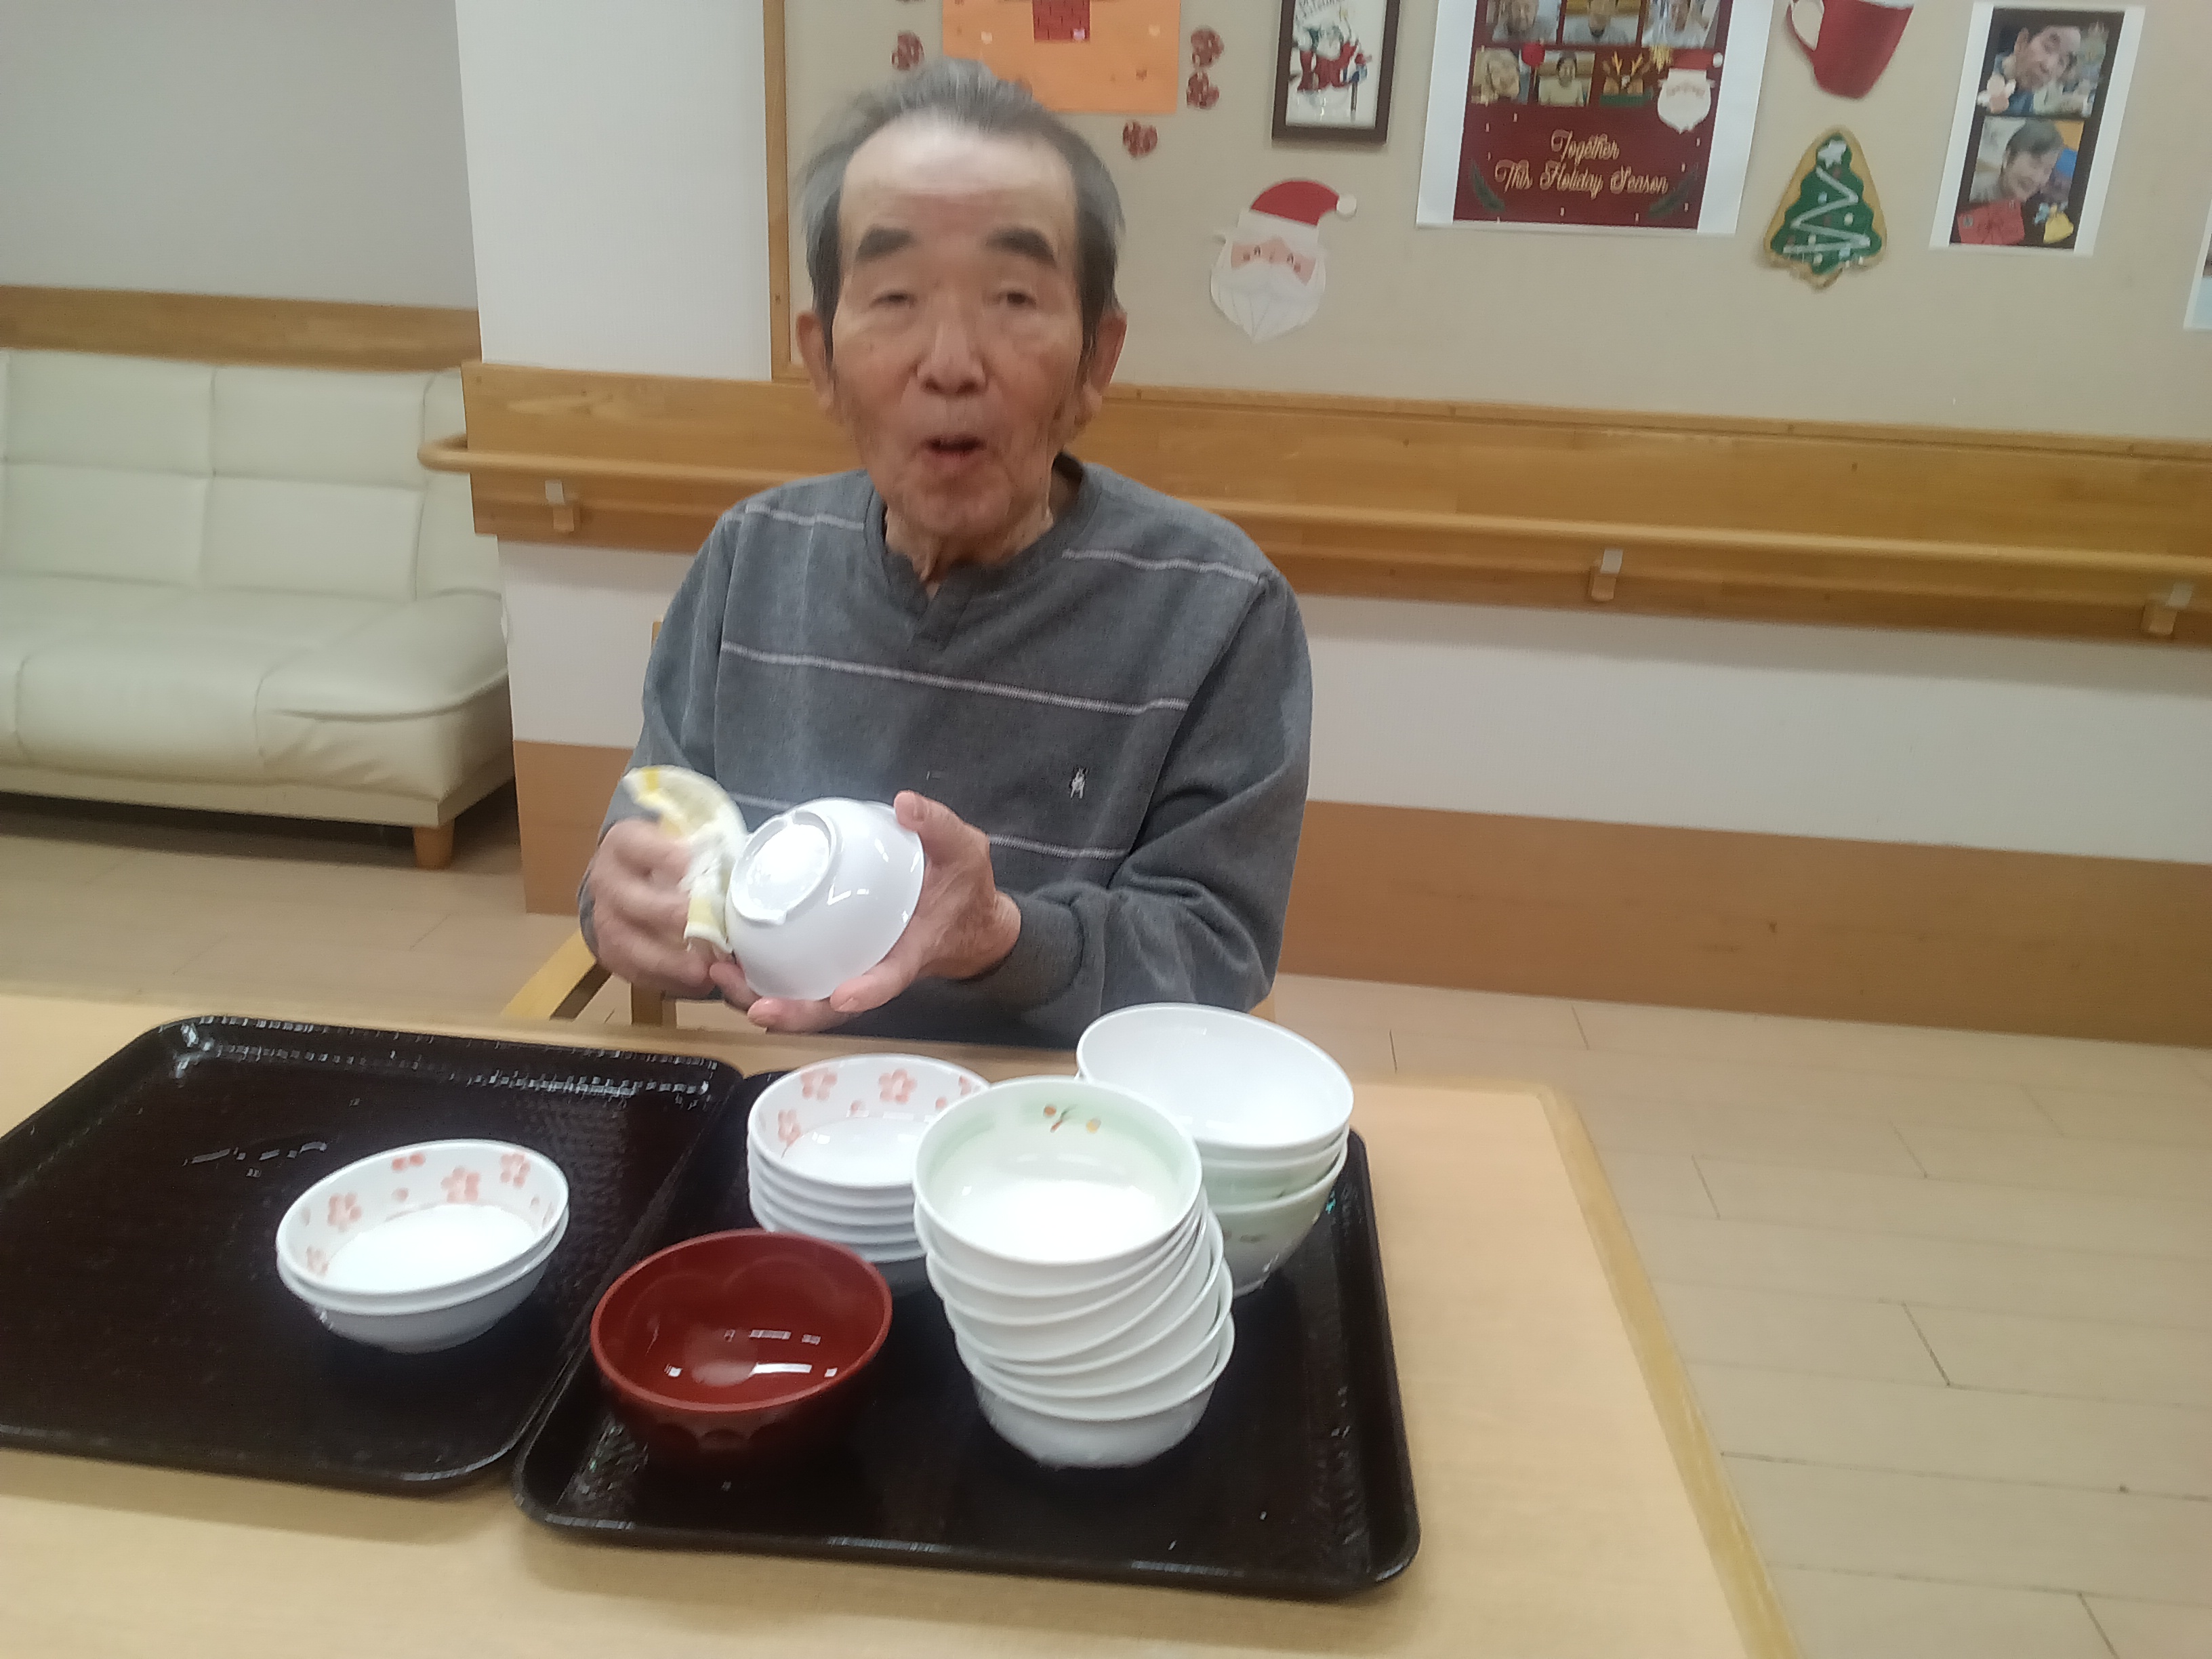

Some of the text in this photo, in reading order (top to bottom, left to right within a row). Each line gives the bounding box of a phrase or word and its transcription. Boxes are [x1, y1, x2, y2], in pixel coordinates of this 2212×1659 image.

[1551, 129, 1620, 166] Together
[1494, 159, 1668, 199] This Holiday Season
